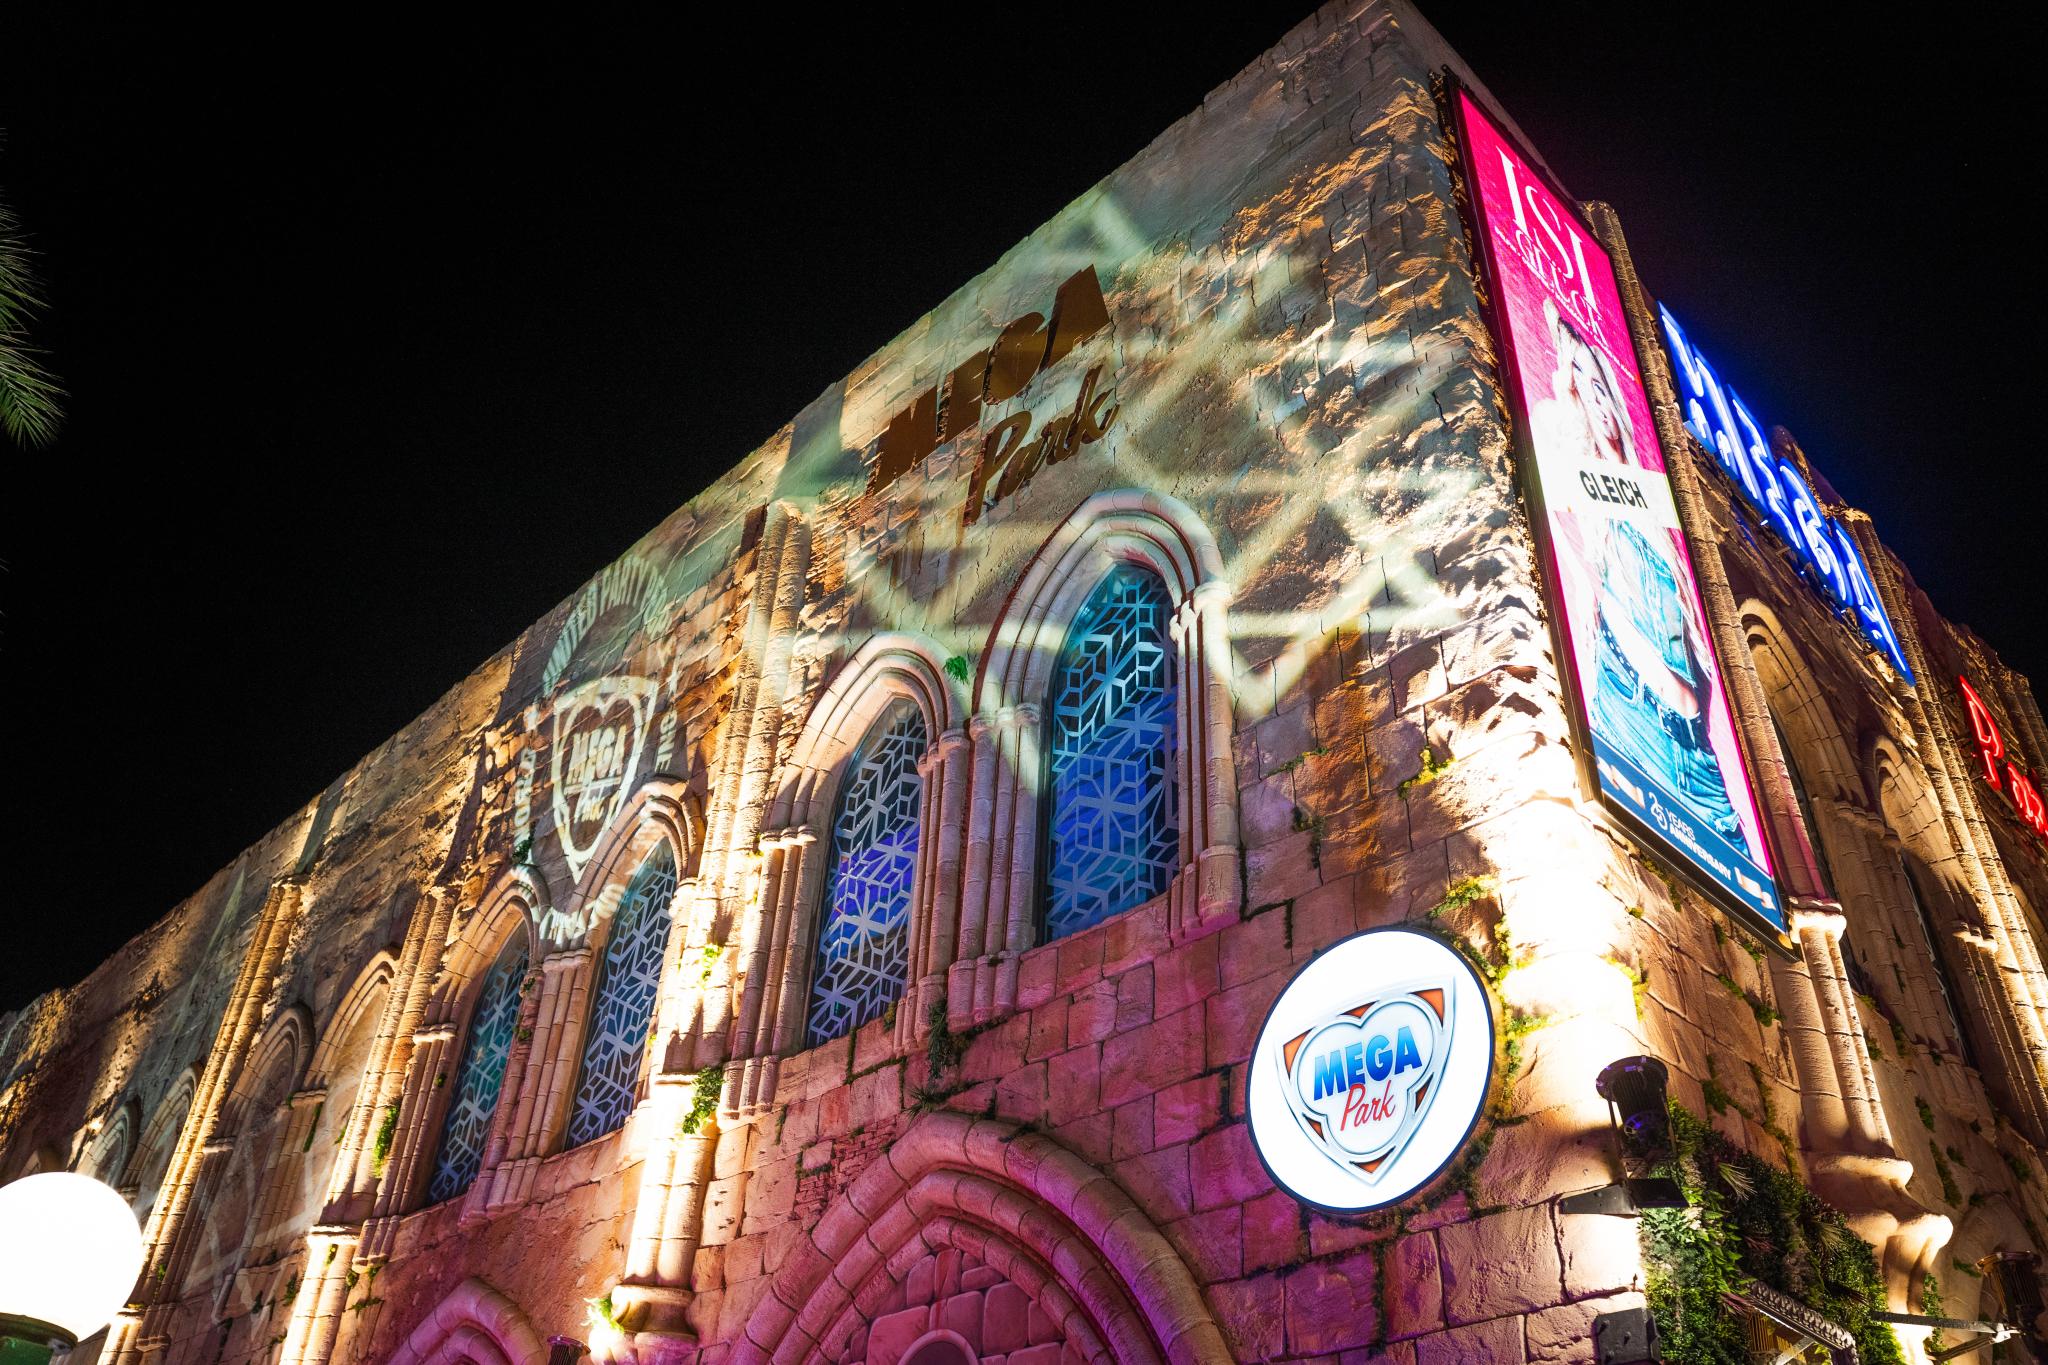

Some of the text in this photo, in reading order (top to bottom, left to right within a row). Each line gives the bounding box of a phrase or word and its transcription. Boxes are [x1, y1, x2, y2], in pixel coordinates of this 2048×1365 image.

[1496, 145, 1602, 320] ISI
[962, 364, 1121, 527] Park
[1579, 469, 1648, 510] GLEICH
[600, 555, 649, 616] PARTY
[566, 724, 628, 787] MEGA
[655, 708, 678, 772] ONE
[1648, 792, 1668, 831] 25
[1665, 808, 1696, 841] YEARS
[1669, 825, 1731, 881] ANNIVERSARY
[1313, 1025, 1423, 1101] MEGA
[1340, 1079, 1396, 1132] Park
